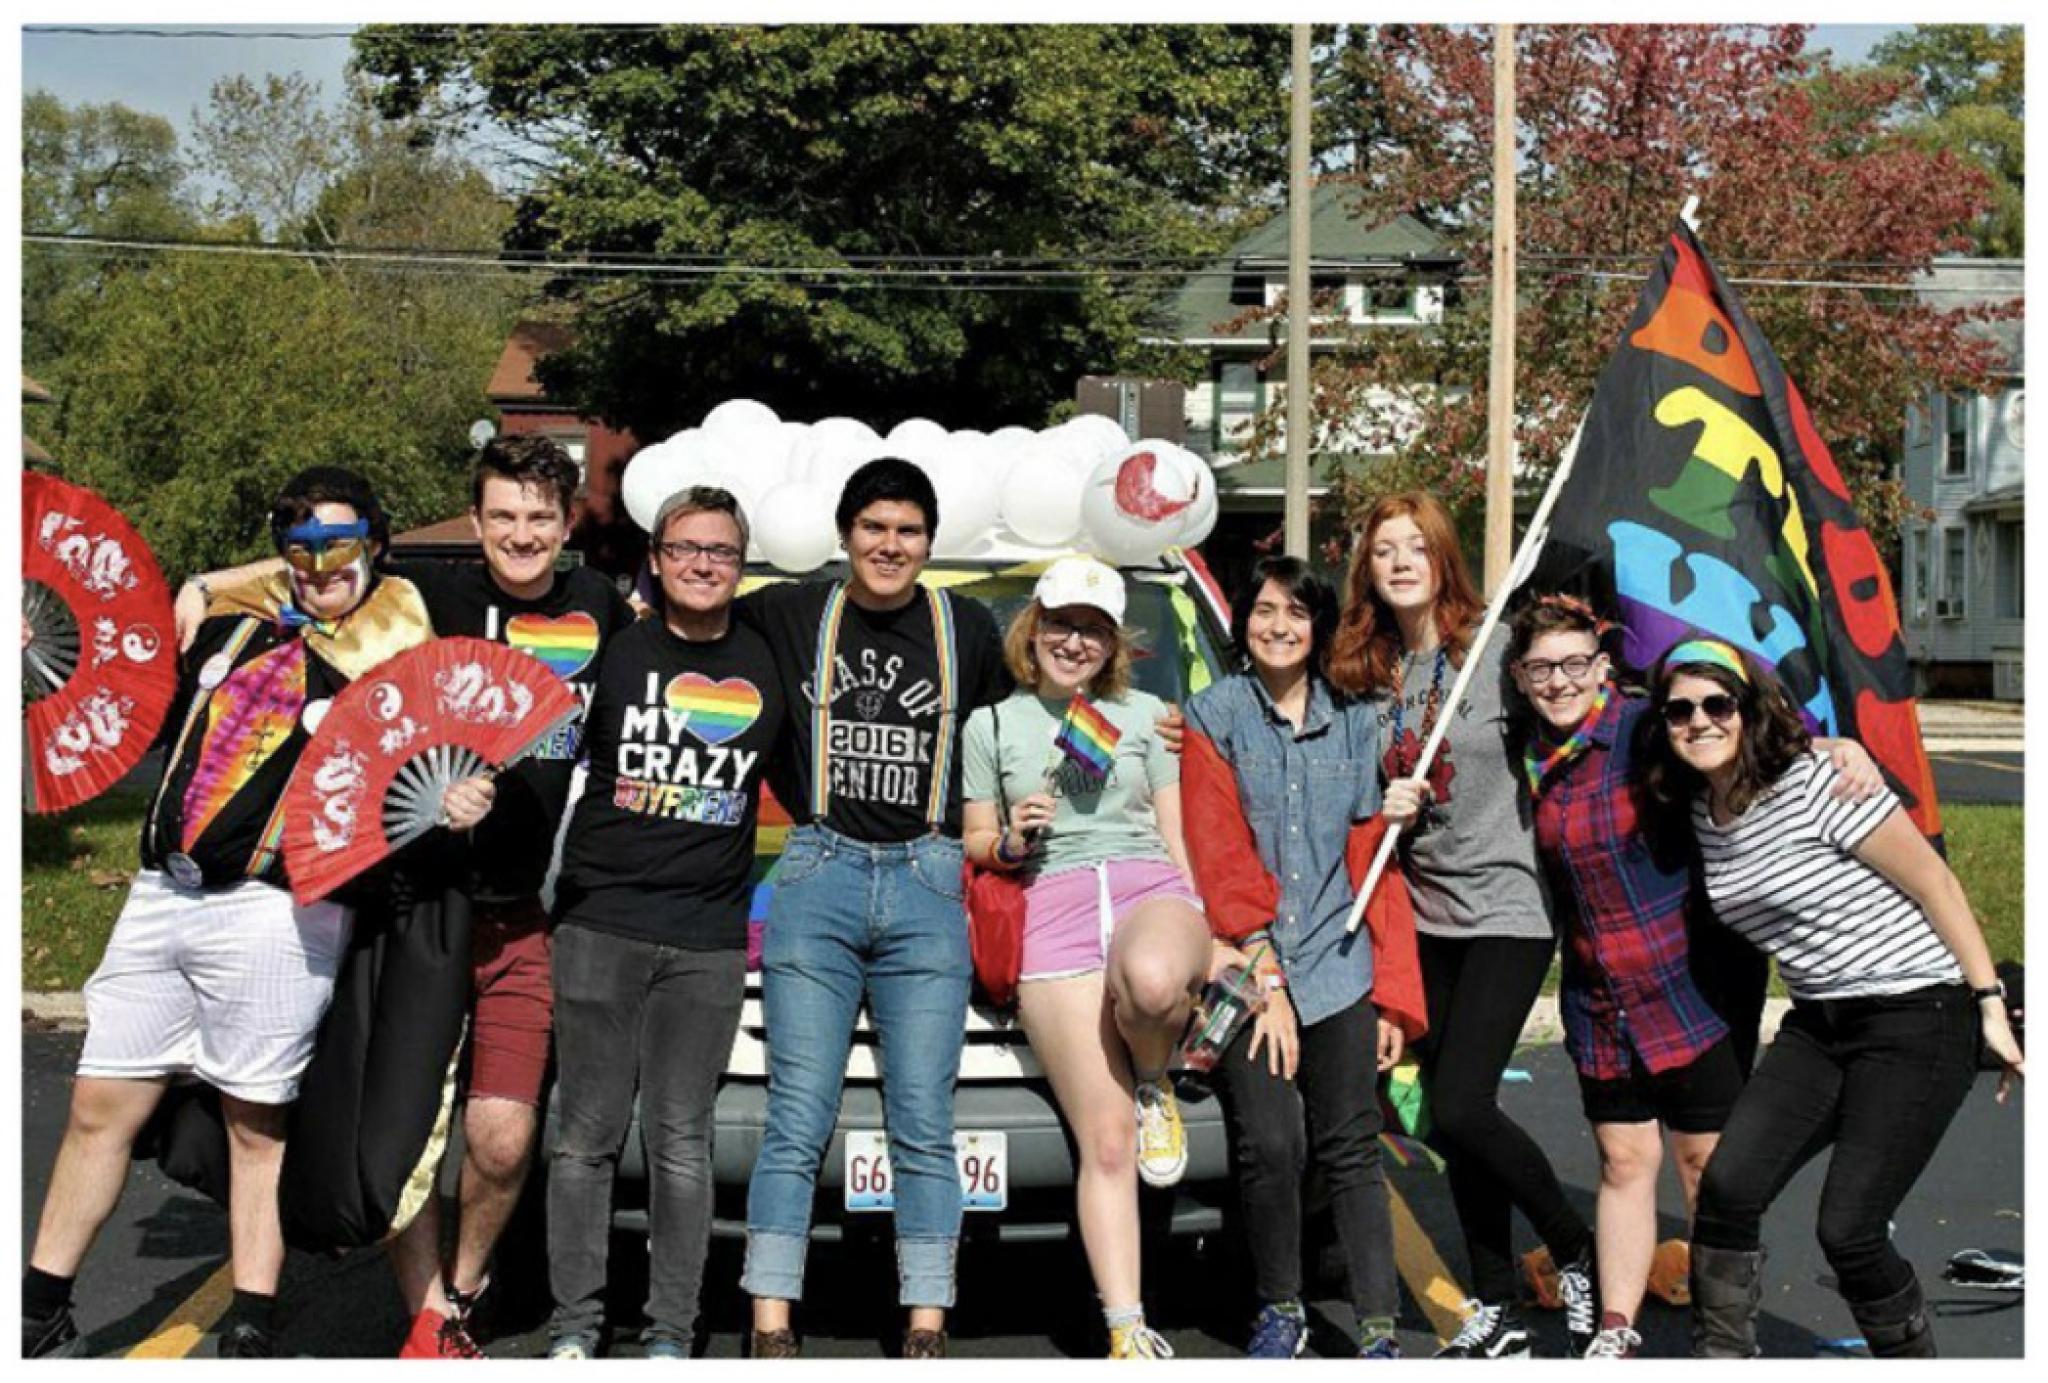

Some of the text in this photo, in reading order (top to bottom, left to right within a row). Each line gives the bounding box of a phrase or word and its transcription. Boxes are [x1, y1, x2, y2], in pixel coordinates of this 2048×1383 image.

[645, 672, 659, 705] I
[622, 704, 691, 745] MY
[830, 724, 907, 757] 2016
[618, 743, 758, 791] CRAZY
